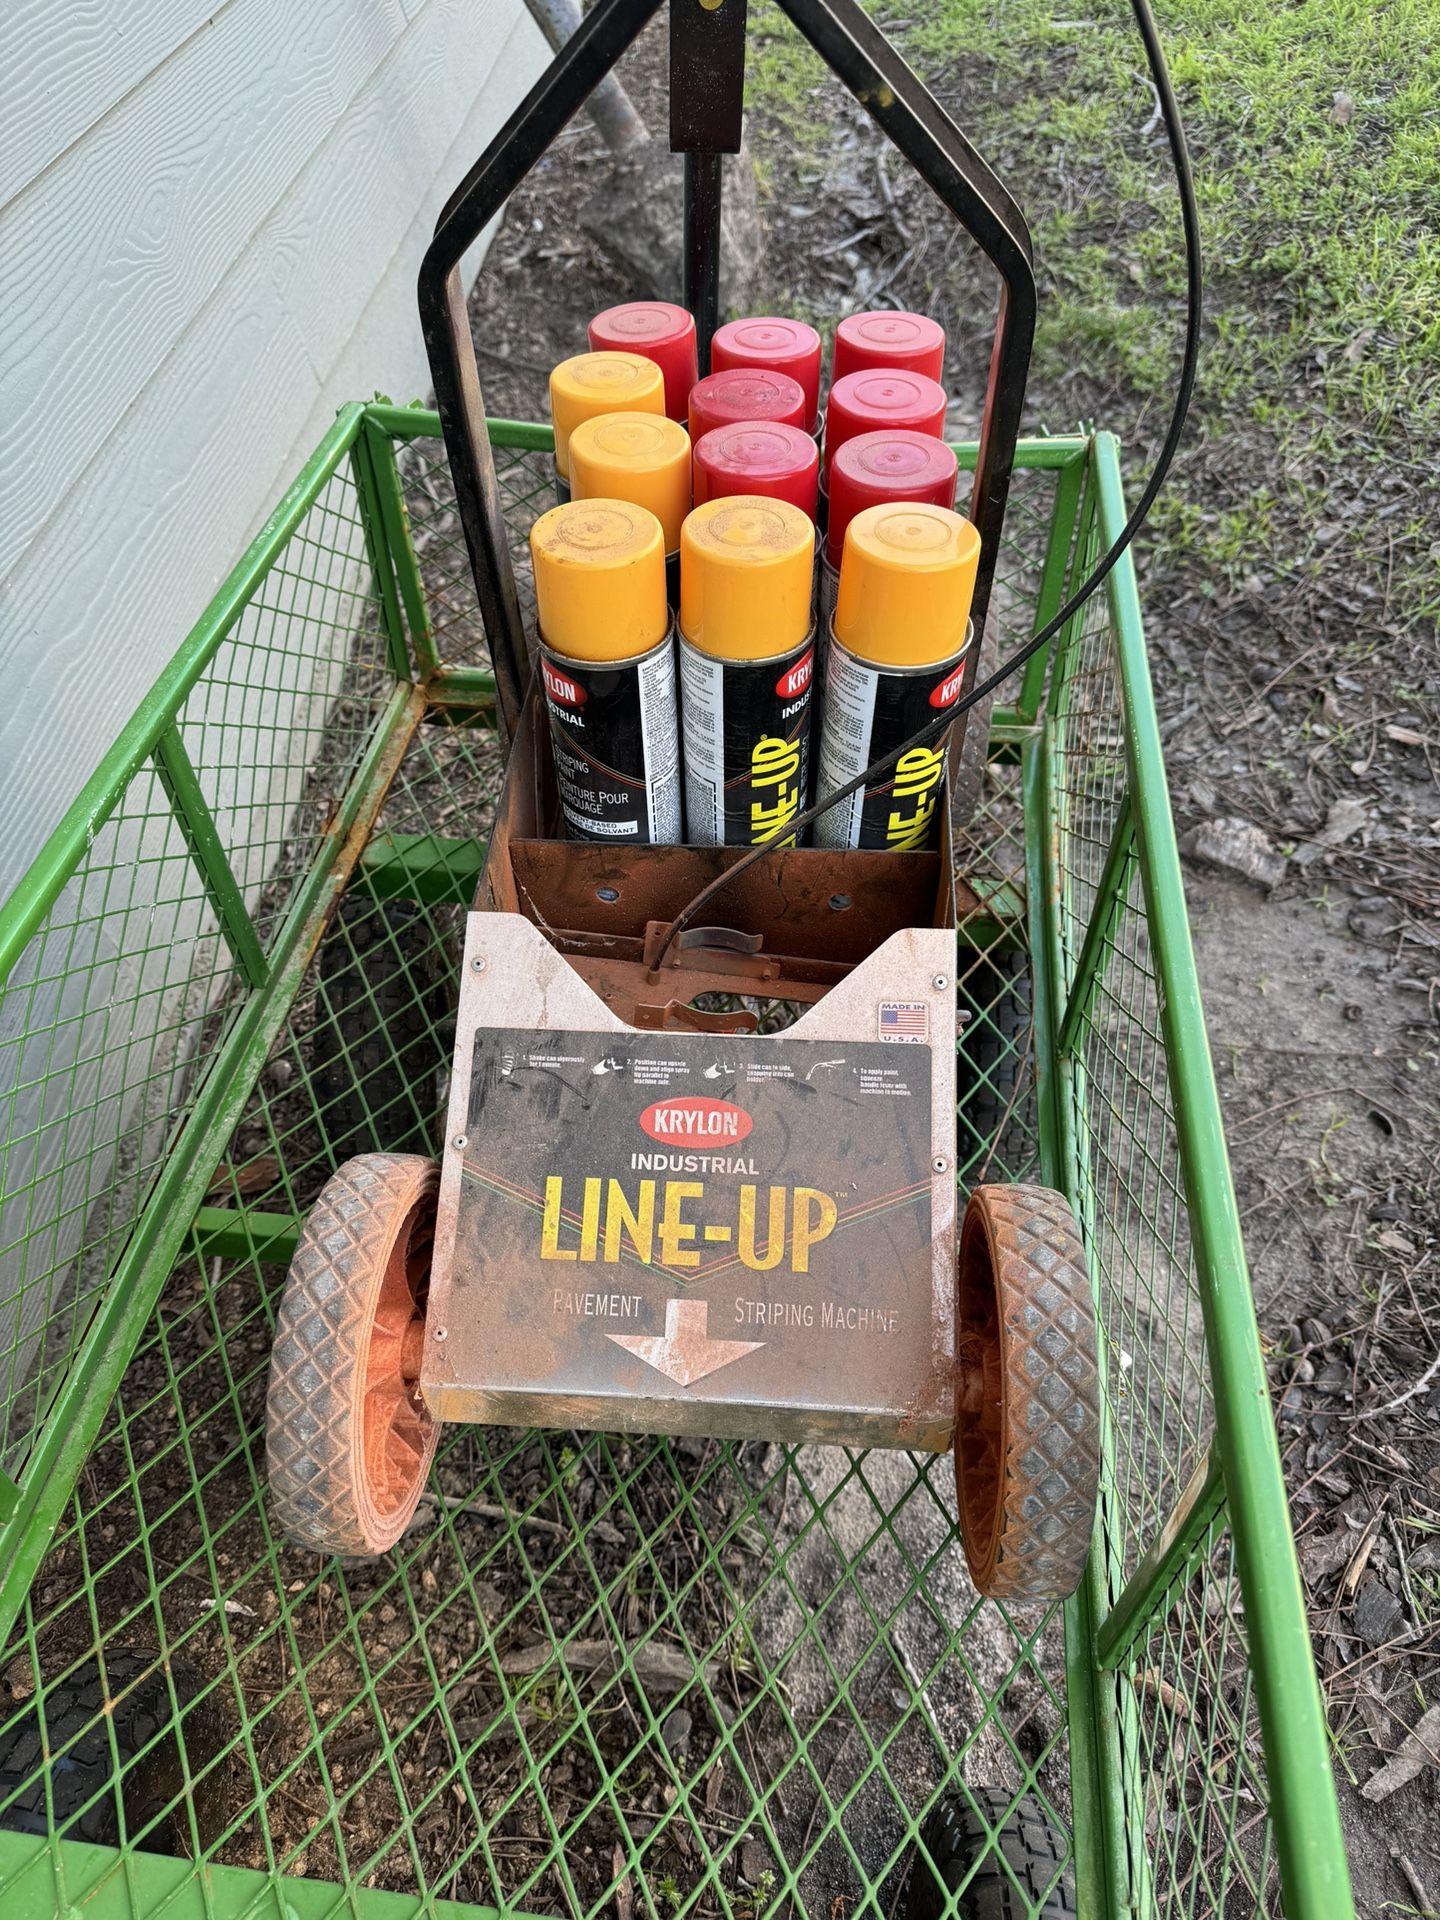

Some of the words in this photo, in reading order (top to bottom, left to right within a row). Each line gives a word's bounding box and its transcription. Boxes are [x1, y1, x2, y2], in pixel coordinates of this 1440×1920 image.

[599, 791, 630, 805] POUR
[884, 1035, 924, 1043] U.S.A.
[653, 1108, 739, 1137] KRYLON
[630, 1152, 760, 1176] INDUSTRIAL
[540, 1175, 839, 1273] LINE-UP
[552, 1288, 642, 1318] PAVEMENT
[734, 1297, 814, 1328] STRIPING
[821, 1302, 900, 1333] MACHINE
